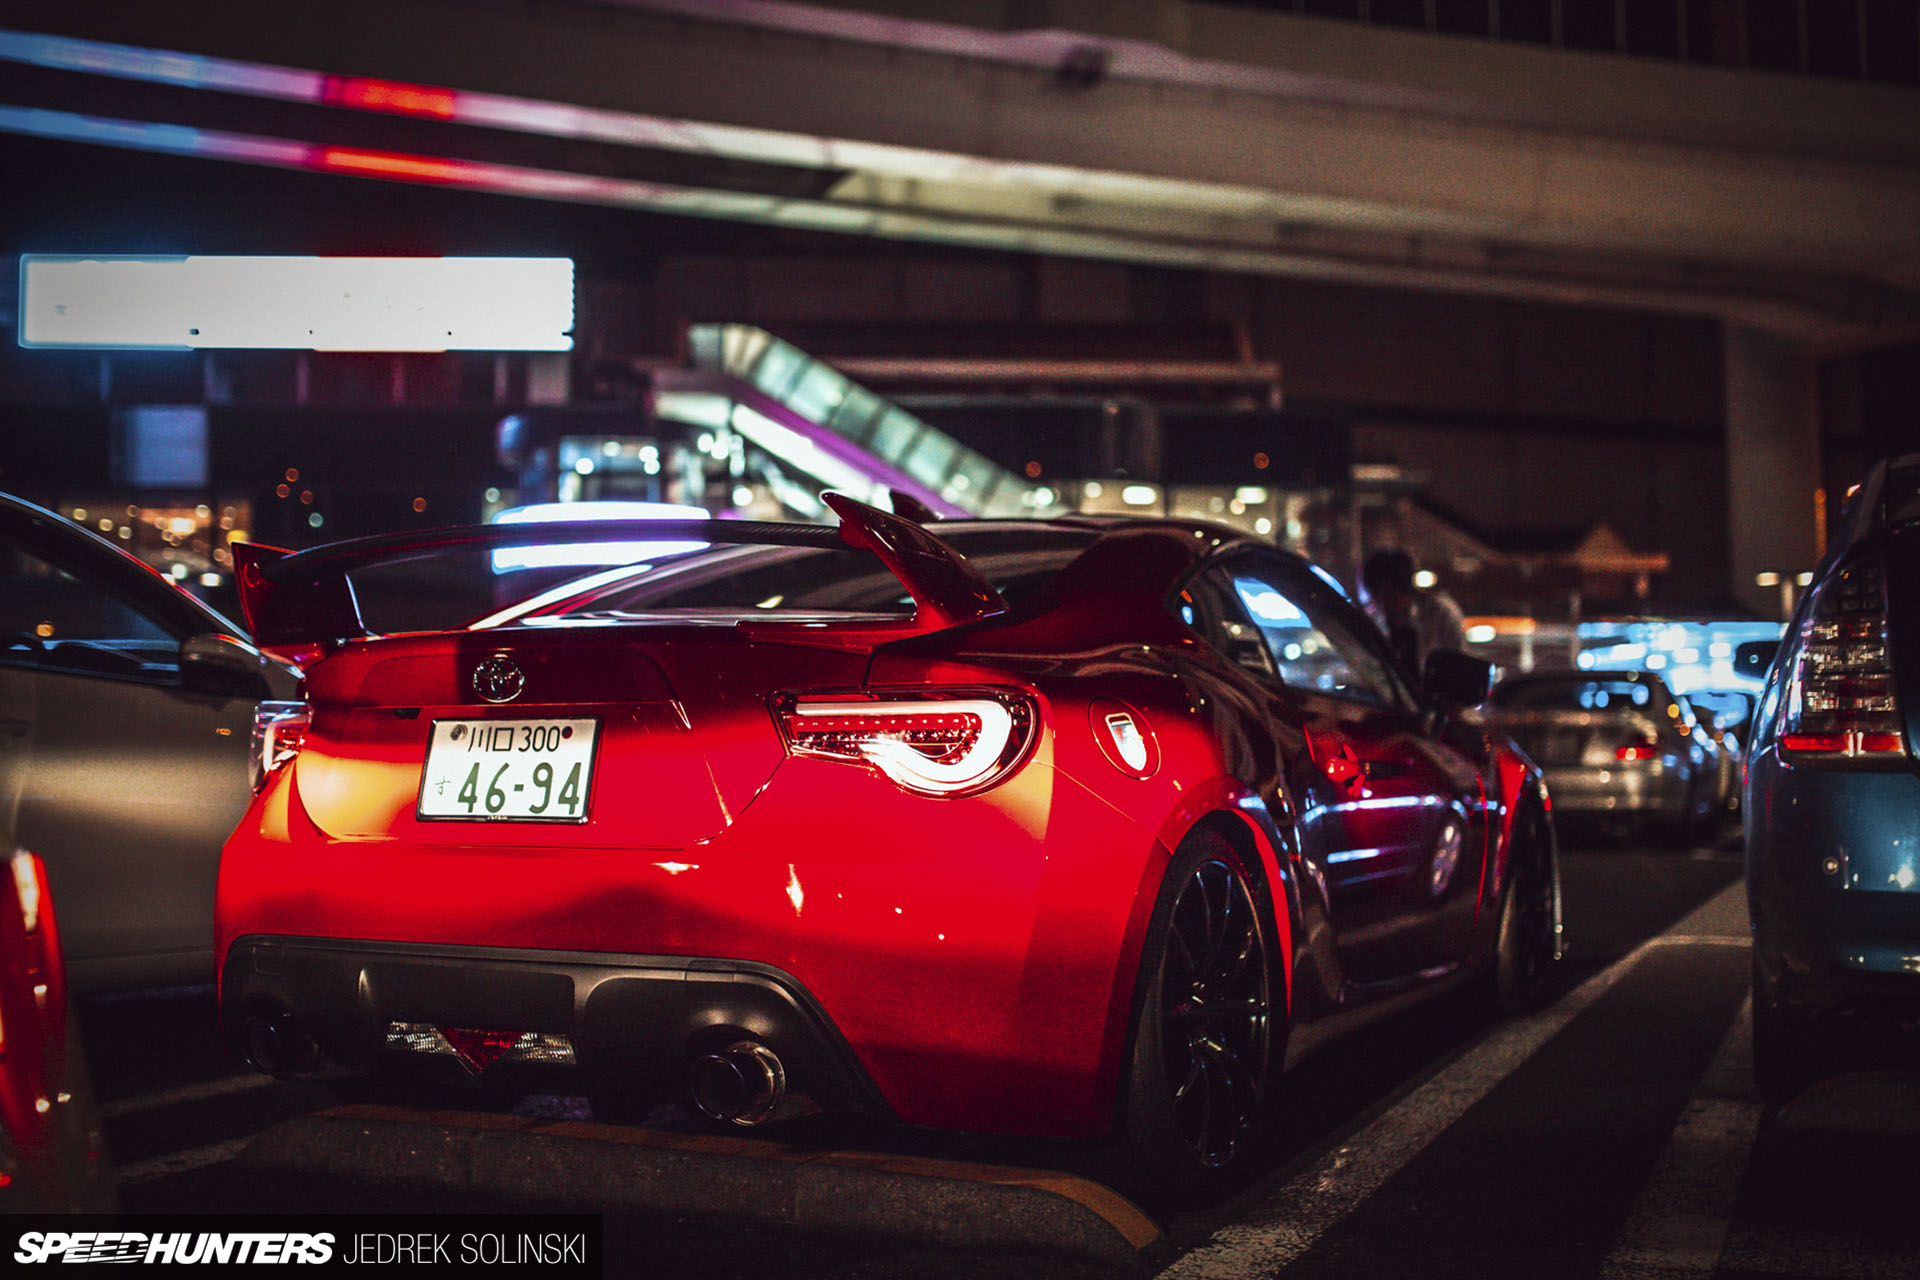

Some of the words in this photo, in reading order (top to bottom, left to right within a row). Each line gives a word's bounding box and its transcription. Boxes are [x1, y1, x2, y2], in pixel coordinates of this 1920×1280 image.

[468, 726, 514, 752] 川口
[518, 726, 560, 752] 300
[457, 762, 582, 815] 46-94
